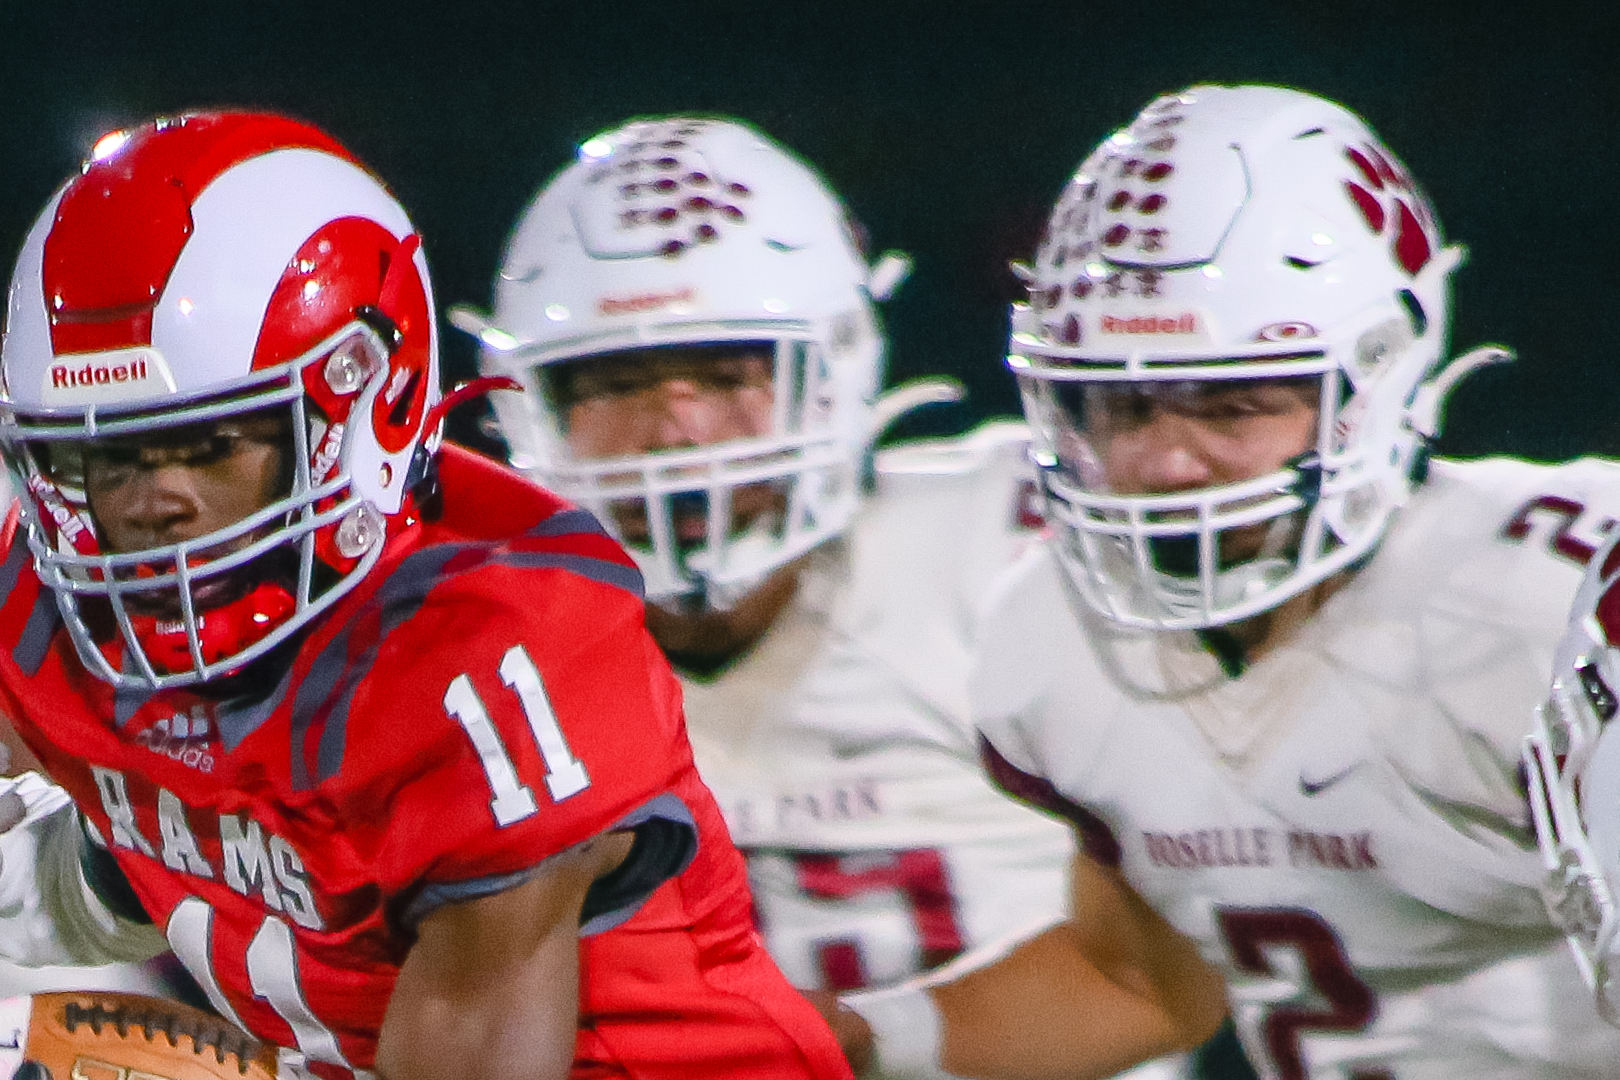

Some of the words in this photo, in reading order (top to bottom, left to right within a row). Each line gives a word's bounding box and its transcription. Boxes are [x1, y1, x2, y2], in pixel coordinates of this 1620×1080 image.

[441, 643, 592, 829] 11
[90, 765, 326, 932] RAMS
[1287, 830, 1378, 872] PARK
